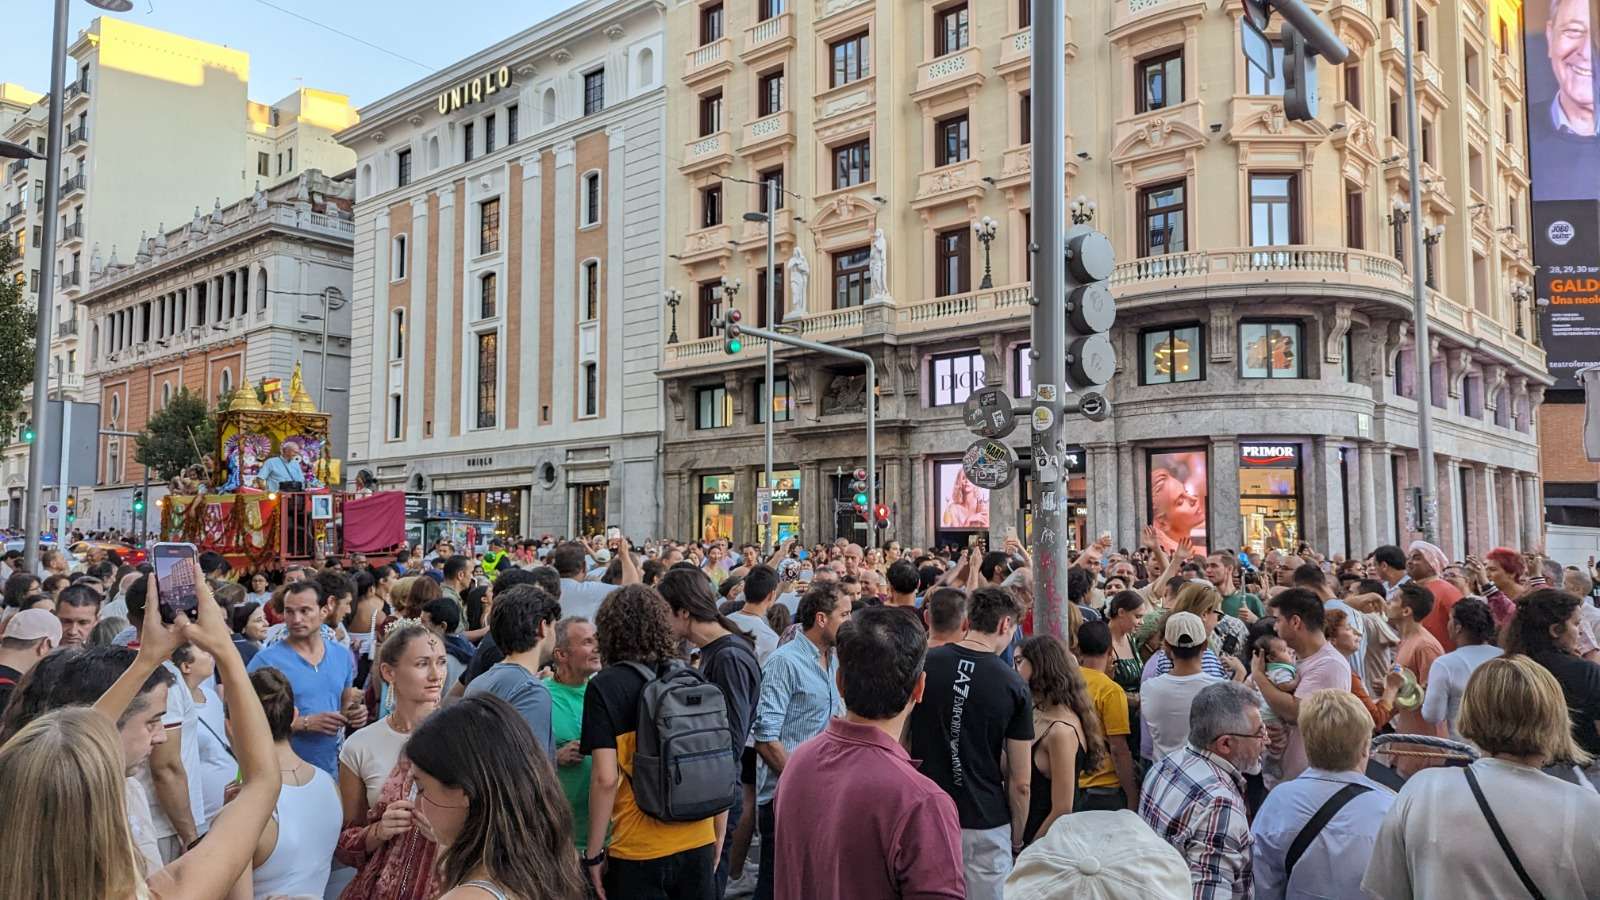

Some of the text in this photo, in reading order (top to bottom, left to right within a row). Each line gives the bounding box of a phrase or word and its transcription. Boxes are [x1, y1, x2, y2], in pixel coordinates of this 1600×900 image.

[438, 66, 509, 114] UNIQLO
[1551, 278, 1600, 293] GALD
[1551, 295, 1573, 305] Una
[940, 370, 985, 391] DIOR
[1242, 446, 1294, 456] PRIMOR
[953, 659, 975, 699] EA7
